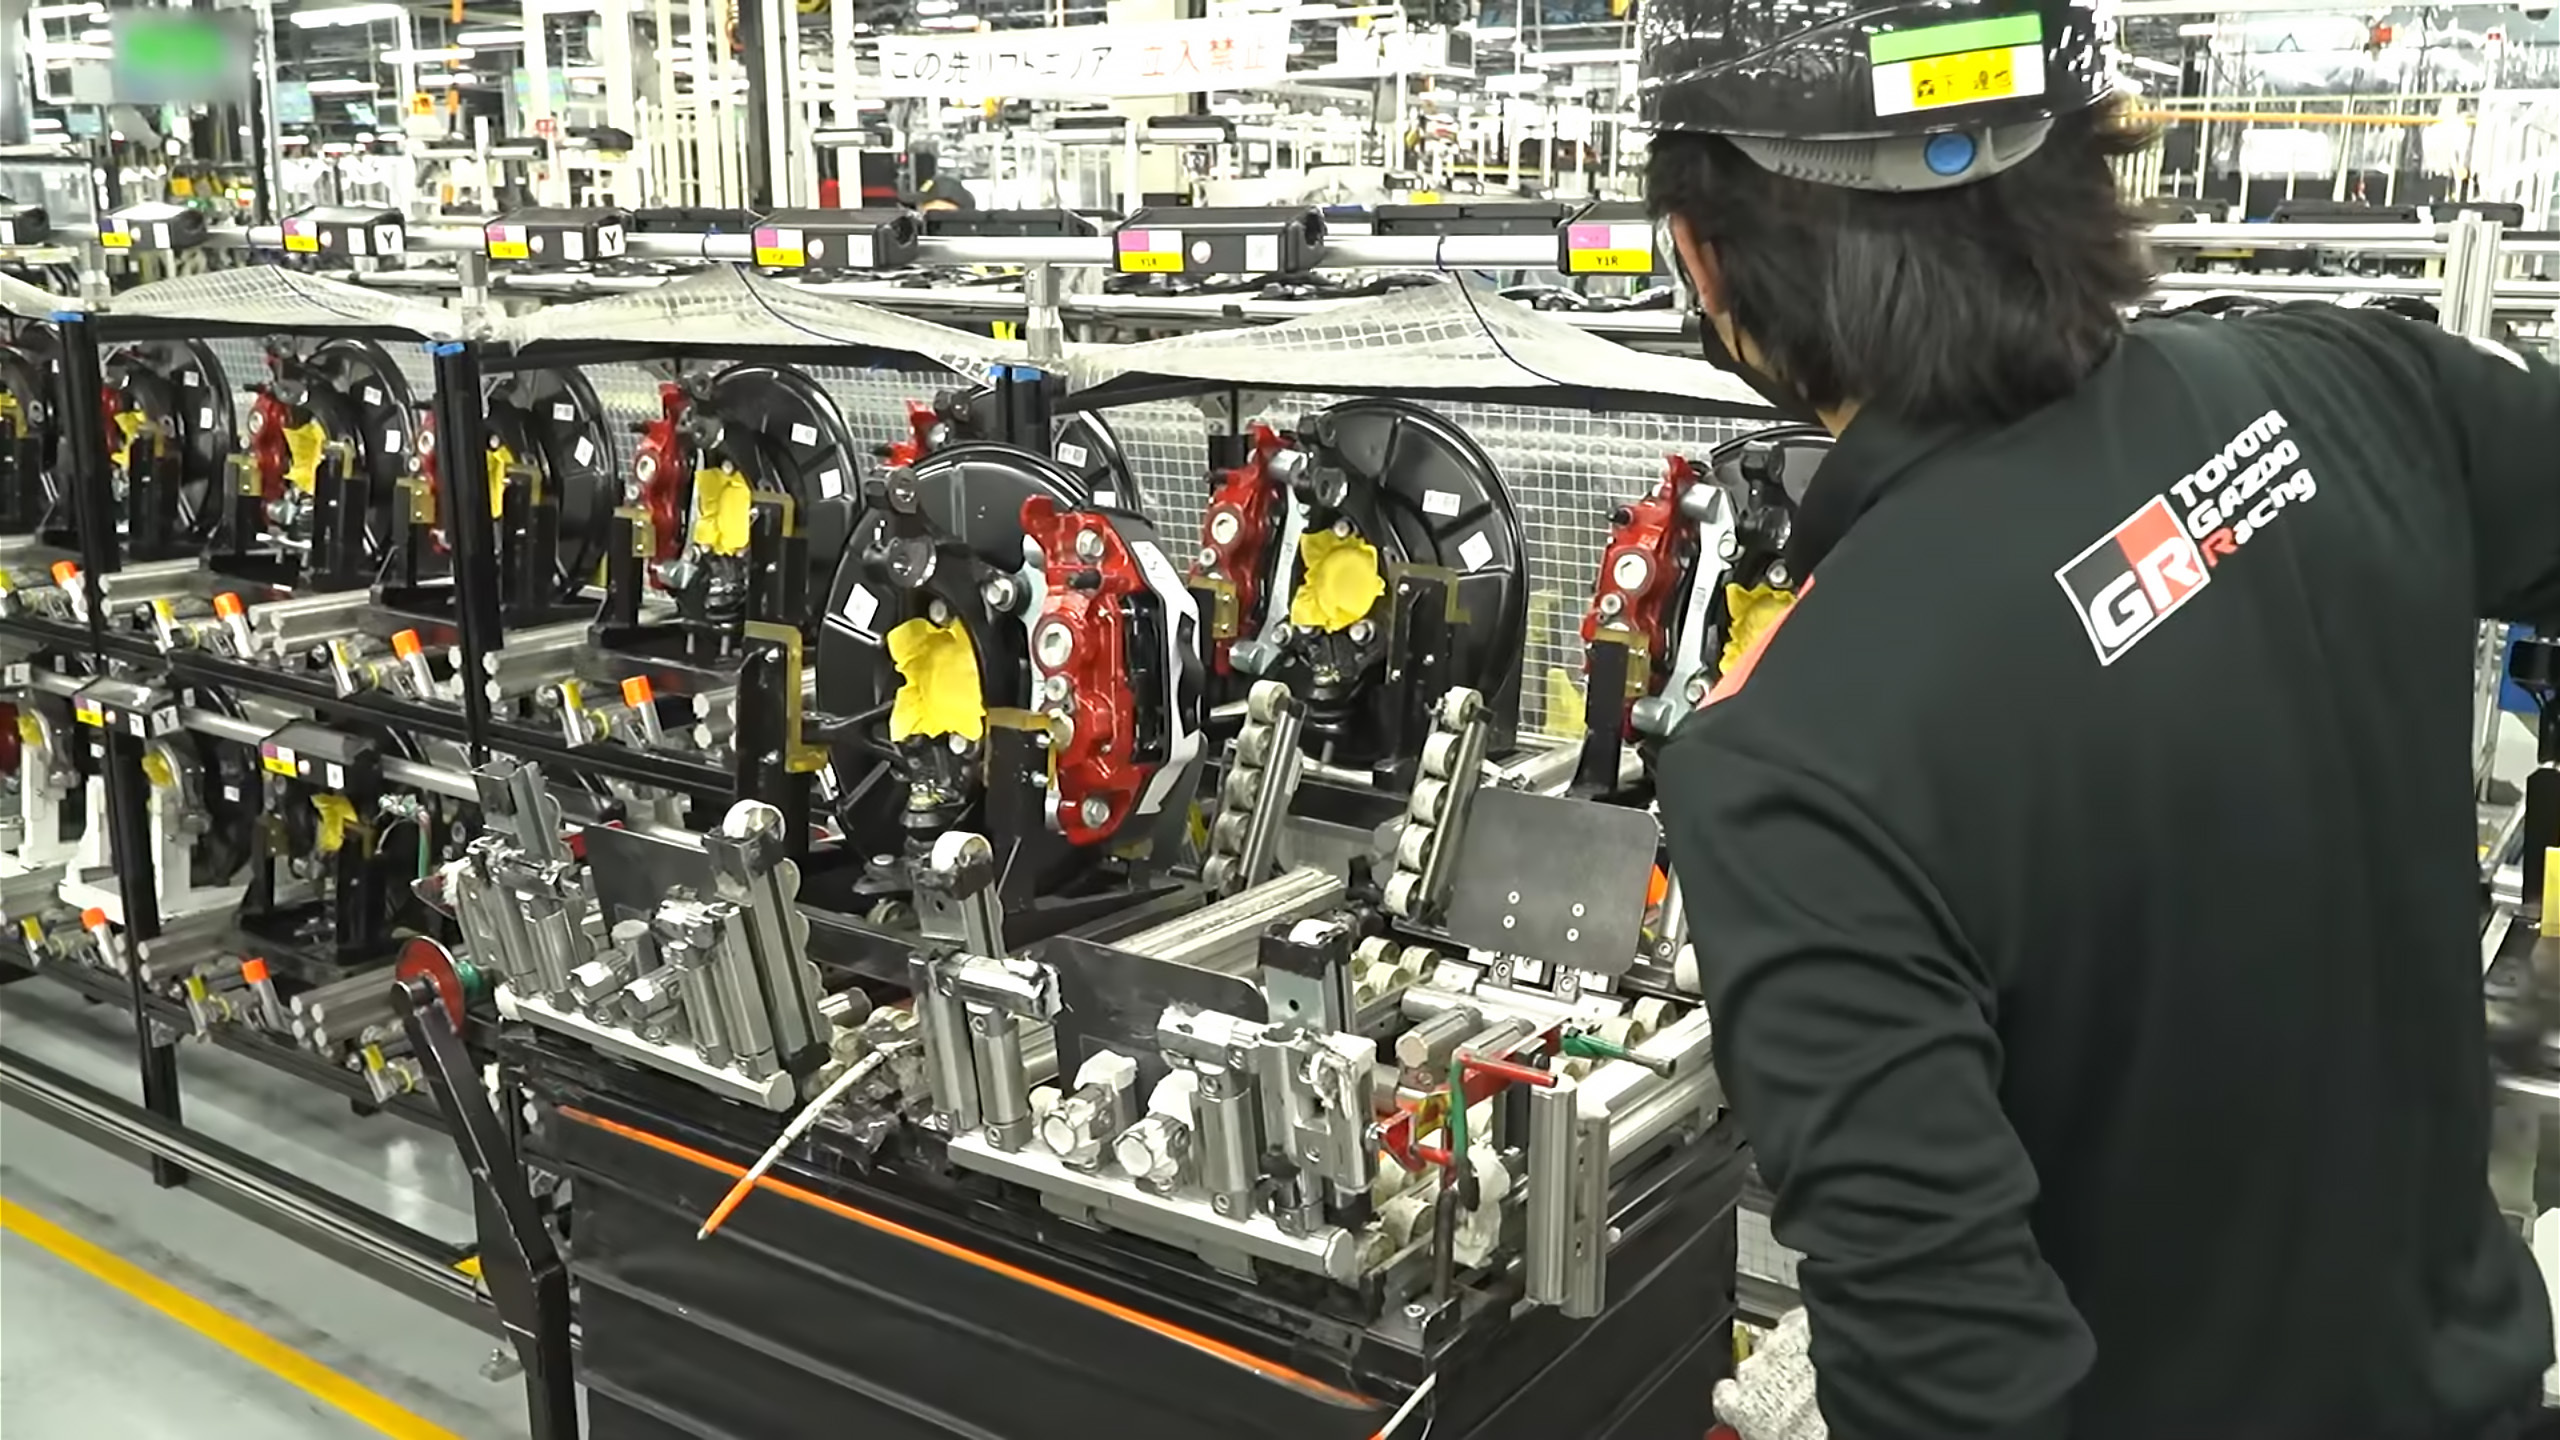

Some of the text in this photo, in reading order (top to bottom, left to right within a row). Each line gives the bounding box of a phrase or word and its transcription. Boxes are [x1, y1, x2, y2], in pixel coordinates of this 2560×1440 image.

[1140, 36, 1267, 79] 立入禁止
[605, 230, 617, 251] Y
[2169, 409, 2288, 507] TOYOTA
[2187, 439, 2300, 539] GAZOO
[2200, 468, 2317, 567] Racing
[2089, 536, 2202, 648] GR
[157, 711, 170, 729] Y
